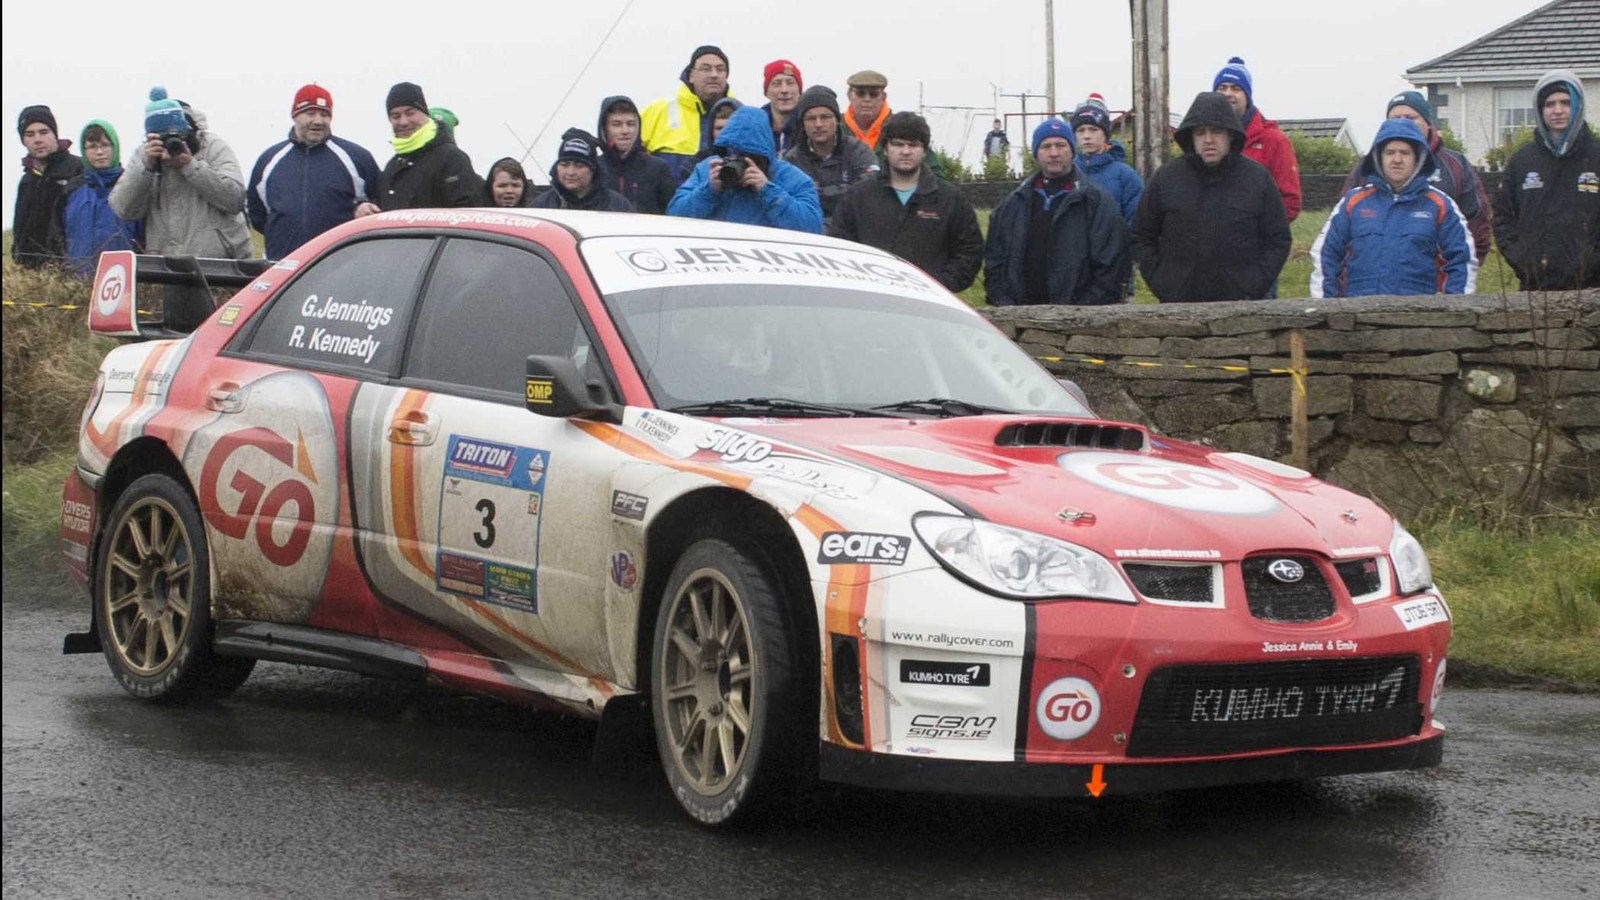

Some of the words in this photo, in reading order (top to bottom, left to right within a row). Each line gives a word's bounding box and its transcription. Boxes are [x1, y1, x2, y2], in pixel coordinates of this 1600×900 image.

[674, 247, 931, 289] JENNINGS
[680, 265, 750, 274] FUELS
[758, 266, 809, 275] AND
[301, 294, 394, 331] G.Jennings
[288, 324, 305, 348] R.
[308, 327, 381, 364] Kennedy
[526, 384, 553, 399] OMP
[455, 441, 512, 468] TRITON
[200, 426, 316, 567] GO
[473, 498, 497, 549] 3
[822, 533, 899, 559] ears
[891, 631, 1015, 649] www.rallycover.com
[1262, 641, 1298, 653] Jessica
[1298, 641, 1324, 651] Annie
[1326, 640, 1335, 651] &
[1336, 640, 1359, 653] Emily
[908, 671, 944, 683] KUMHO
[944, 673, 970, 684] TYRE
[1044, 692, 1093, 722] GO
[1190, 686, 1304, 722] KUMHO
